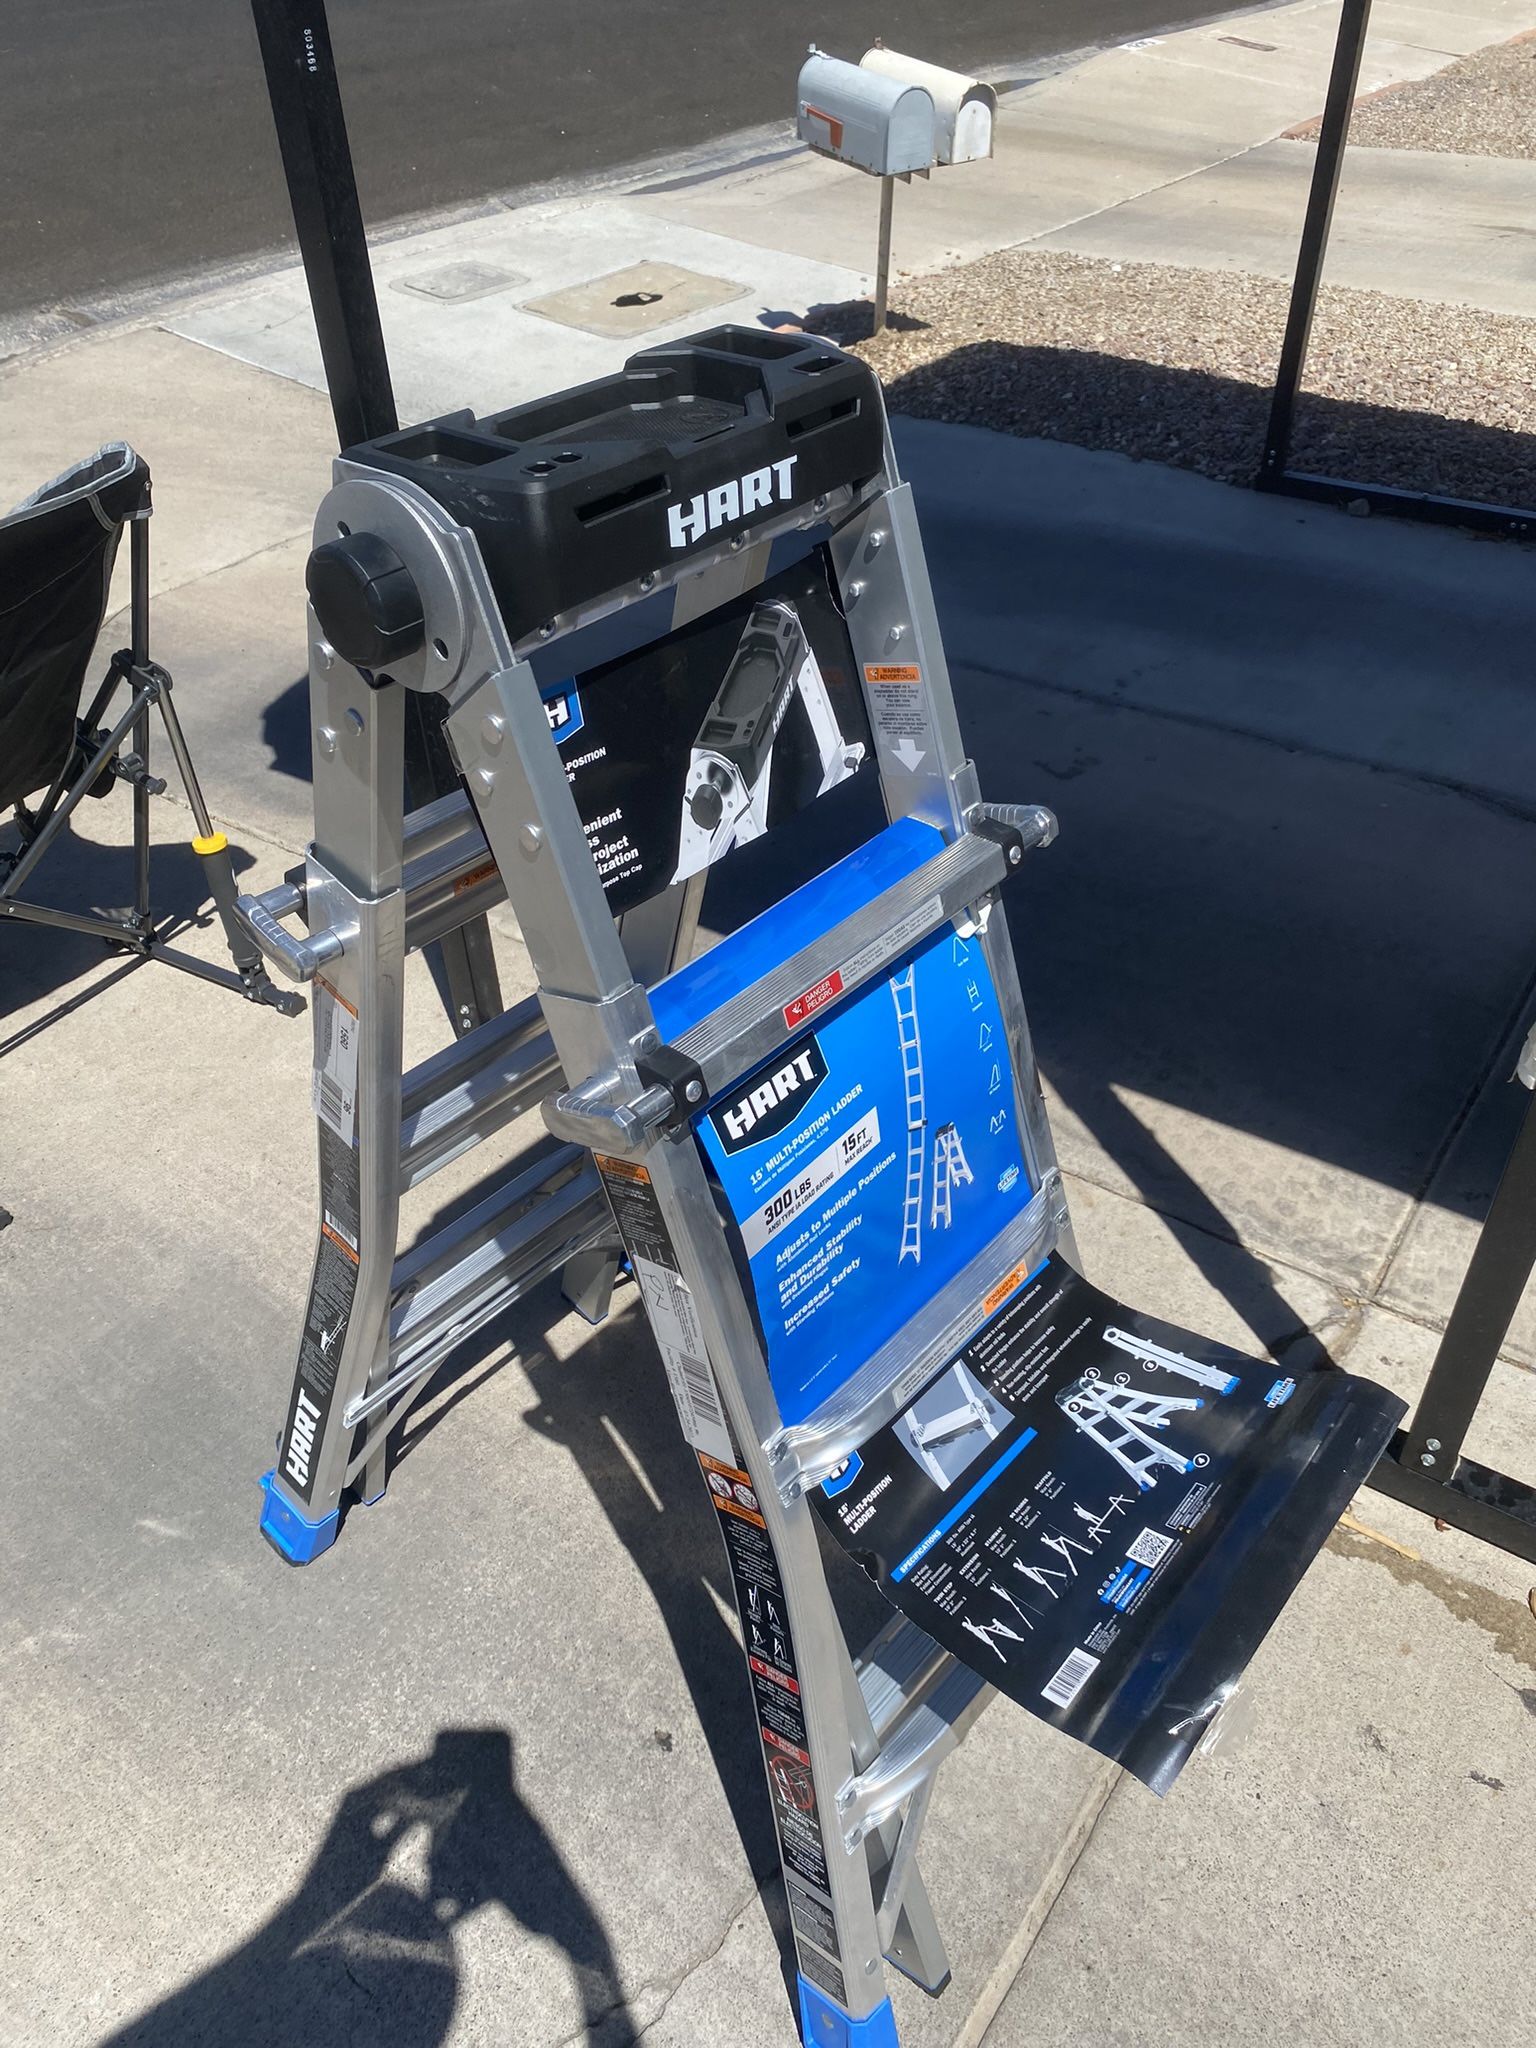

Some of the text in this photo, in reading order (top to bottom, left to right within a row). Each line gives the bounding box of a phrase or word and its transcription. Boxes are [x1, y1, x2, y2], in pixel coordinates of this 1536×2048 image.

[667, 454, 798, 548] HART
[772, 677, 796, 734] HART
[583, 807, 623, 835] enient
[593, 835, 630, 862] roject
[597, 847, 639, 875] ization
[803, 979, 830, 1004] DANGER
[806, 986, 833, 1011] PELIGRO
[722, 1048, 816, 1141] HART
[749, 1081, 863, 1186] 15' MULTI-POSITION LADDER
[841, 1128, 870, 1157] 15 FT
[843, 1149, 859, 1166] MAX
[763, 1177, 812, 1226] 300 LBS
[767, 1170, 834, 1234] ANSI TYPE IA LOAD RATING
[774, 1149, 896, 1267] Adjusts to Multiple Positions
[778, 1211, 863, 1293] Enhanced Stability
[779, 1240, 844, 1303] and Durability
[783, 1254, 861, 1329] Increased Safety
[285, 1387, 322, 1488] HART
[836, 1501, 850, 1517] 15'
[842, 1473, 892, 1527] MULTI-POSITION
[848, 1504, 877, 1534] LADDER
[898, 1527, 941, 1574] SPECIFICATIONS
